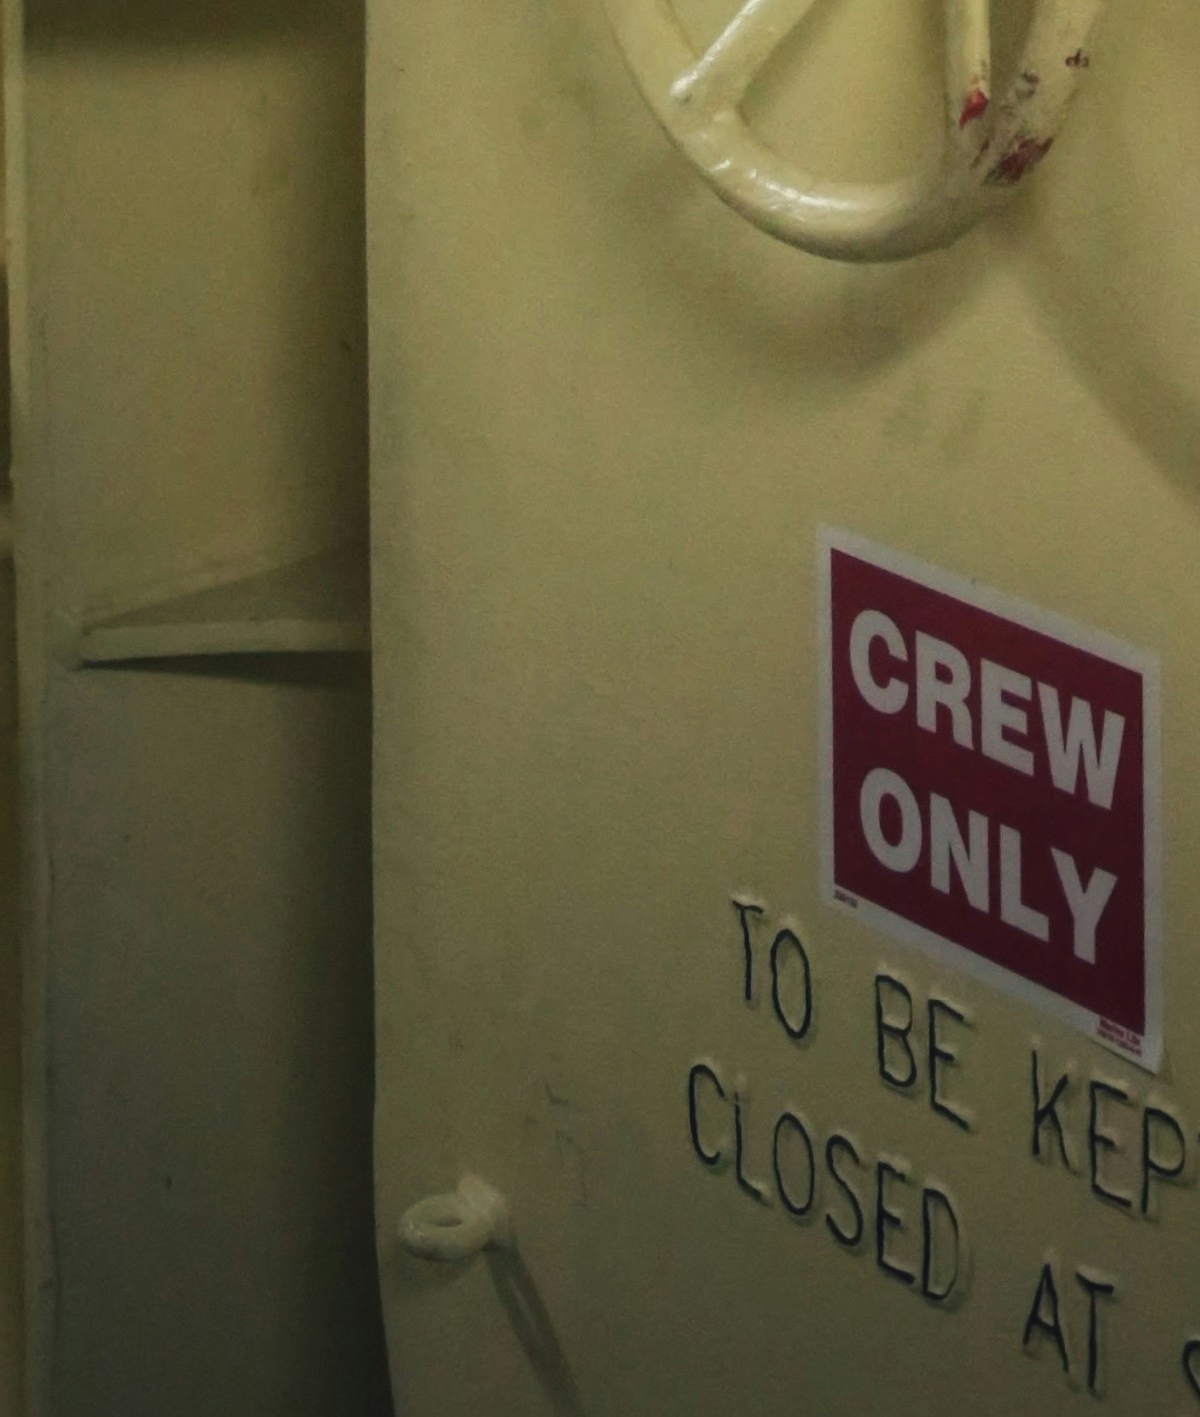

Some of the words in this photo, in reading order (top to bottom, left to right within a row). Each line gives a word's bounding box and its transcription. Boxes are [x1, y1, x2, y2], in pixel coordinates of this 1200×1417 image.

[849, 608, 1126, 812] CREW
[859, 766, 1118, 966] ONLY
[731, 893, 813, 1041] TO
[873, 969, 974, 1132] BE
[687, 1060, 965, 1303] CLOSED
[1021, 1256, 1116, 1394] AT
